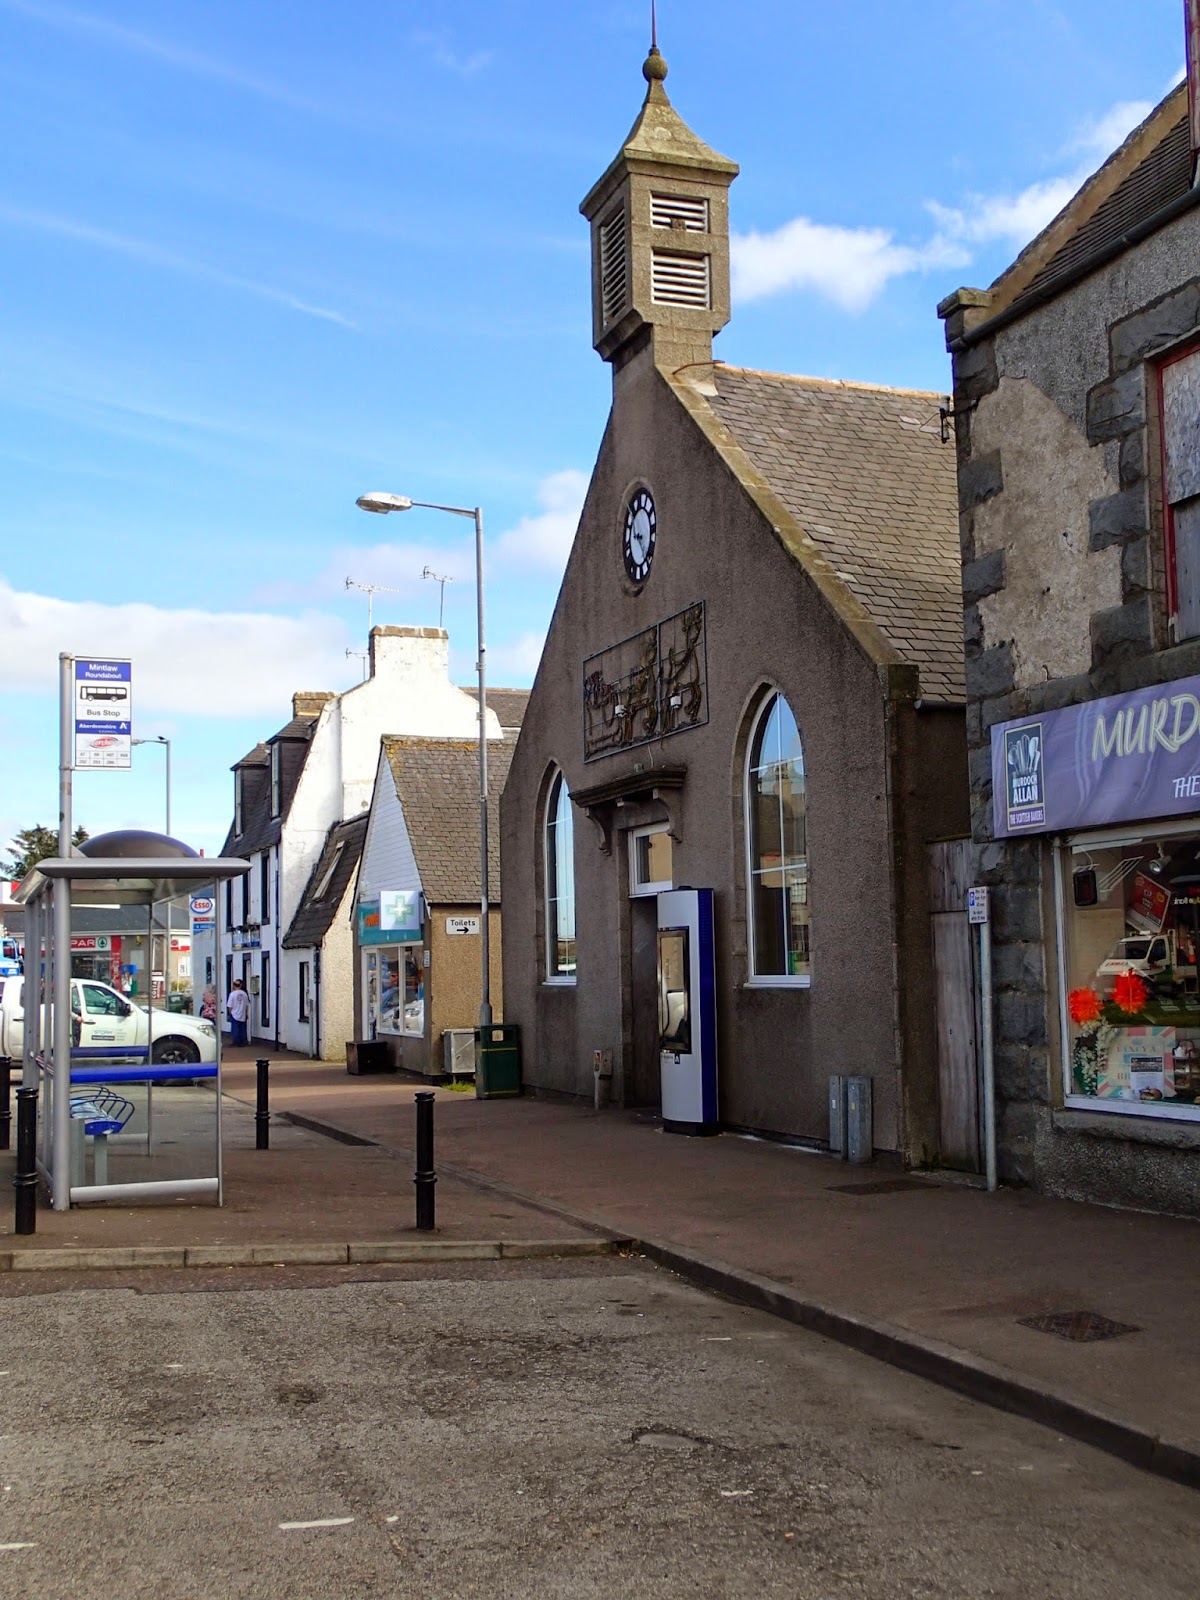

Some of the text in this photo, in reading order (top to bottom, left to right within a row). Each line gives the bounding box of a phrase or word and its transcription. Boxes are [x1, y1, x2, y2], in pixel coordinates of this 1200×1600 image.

[103, 710, 121, 719] Stop
[1013, 774, 1037, 788] MURDOCH
[1172, 775, 1200, 798] THE
[1013, 785, 1038, 804] ALLAN
[194, 901, 210, 909] Esso
